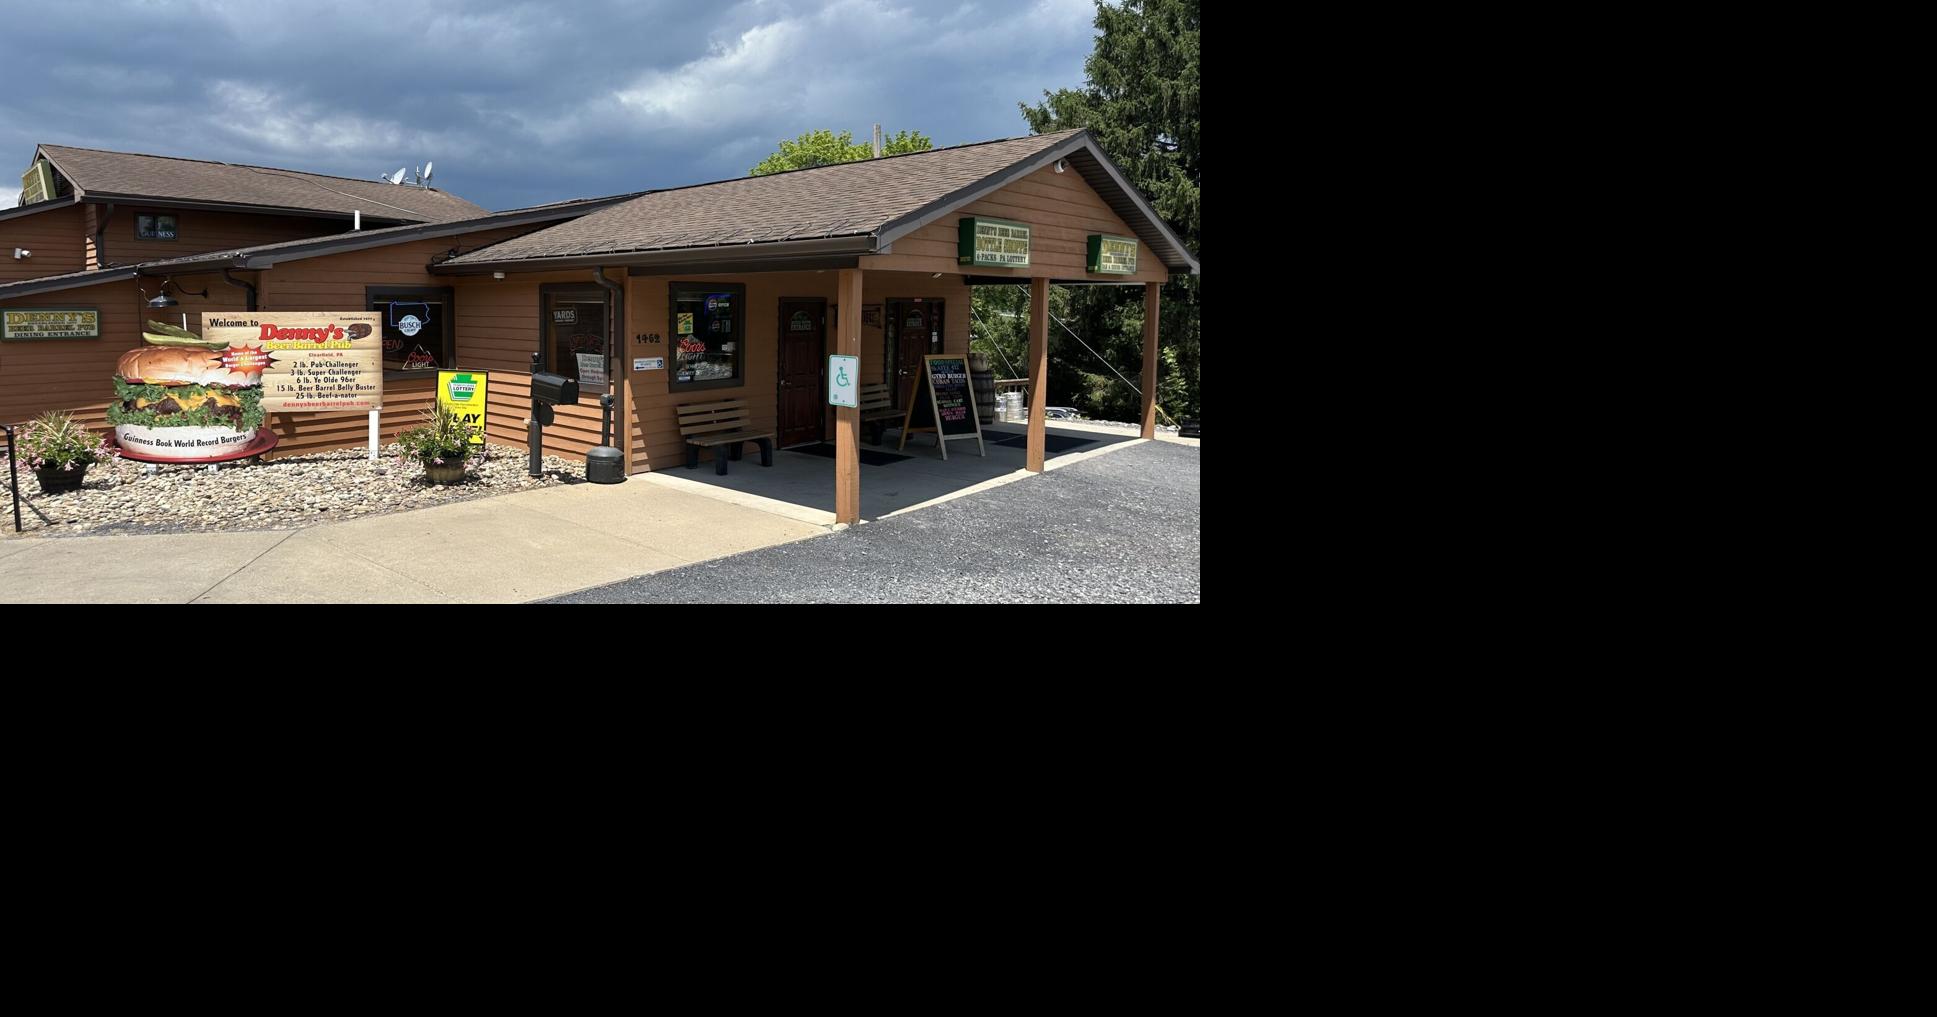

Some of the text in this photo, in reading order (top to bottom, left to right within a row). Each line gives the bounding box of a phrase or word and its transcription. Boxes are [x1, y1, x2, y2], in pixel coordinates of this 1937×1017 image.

[553, 310, 576, 320] YARDS
[209, 318, 259, 327] Welcome to
[399, 321, 421, 329] BUSCH
[258, 323, 344, 344] Denny's
[266, 340, 352, 350] Beer Barrel Pub
[308, 369, 326, 377] Super
[328, 368, 361, 377] Challenger
[283, 400, 370, 408] dennysbeerbarrelpub.com
[453, 413, 481, 423] LAY
[123, 432, 247, 448] Guinness Book World Record Burgers
